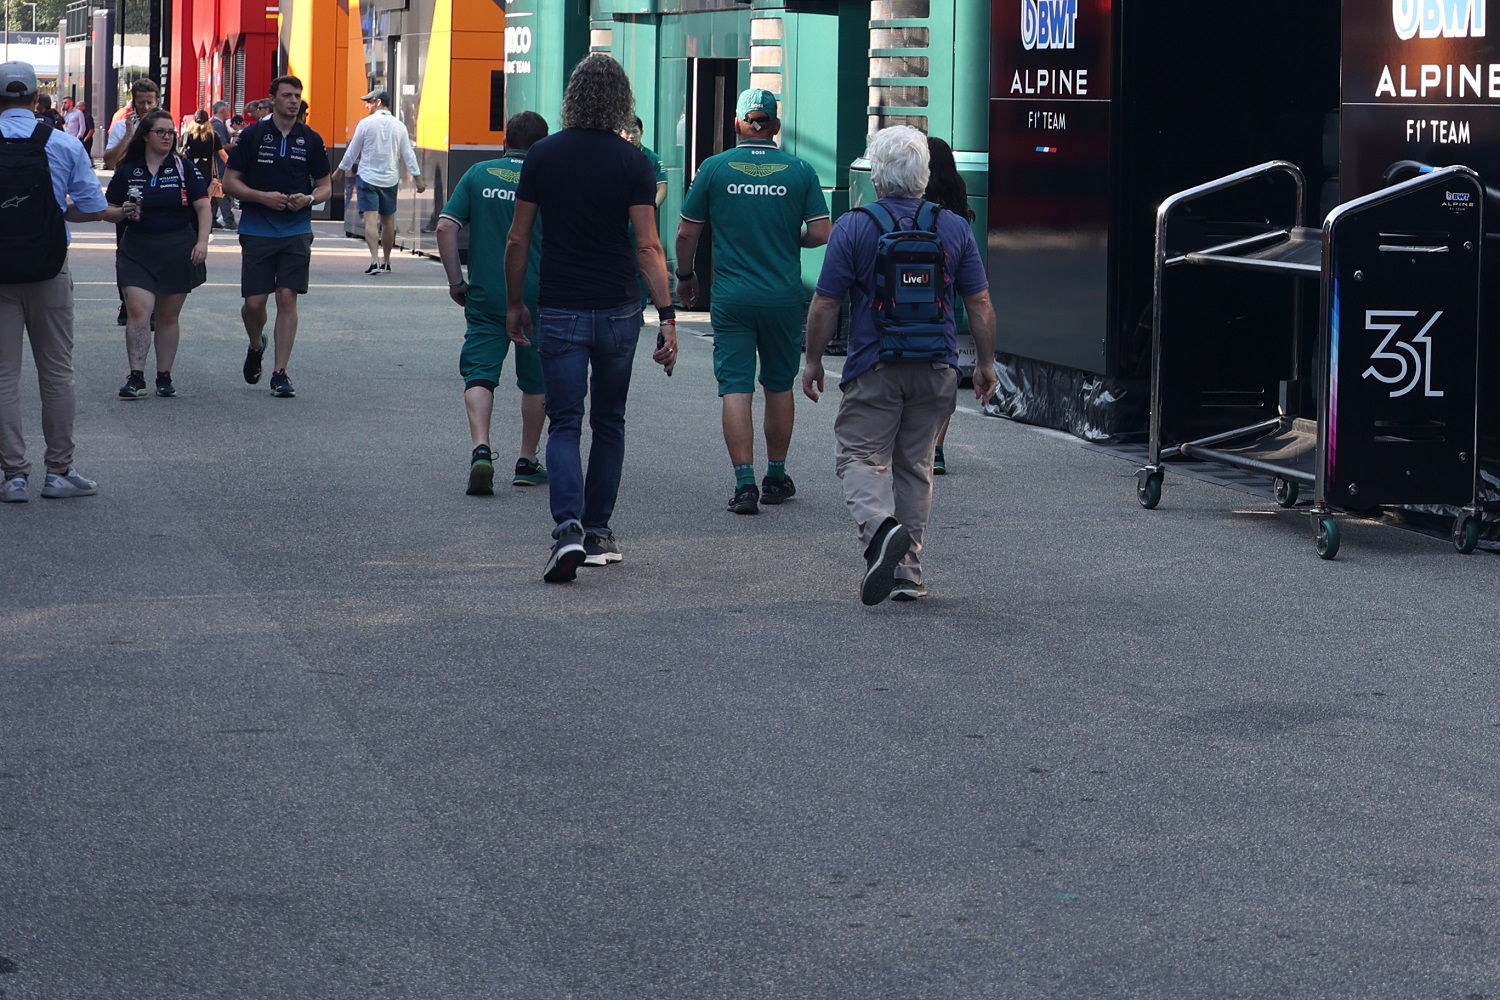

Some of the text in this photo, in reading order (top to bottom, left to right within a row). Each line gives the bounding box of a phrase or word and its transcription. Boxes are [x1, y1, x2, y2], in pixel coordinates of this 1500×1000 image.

[1010, 69, 1088, 95] ALPINE
[1042, 111, 1066, 130] TEAM
[1430, 120, 1471, 144] TEAM
[727, 183, 787, 197] aramco
[1453, 192, 1470, 201] BWT
[903, 272, 929, 284] LiveU
[1361, 309, 1444, 398] 31
